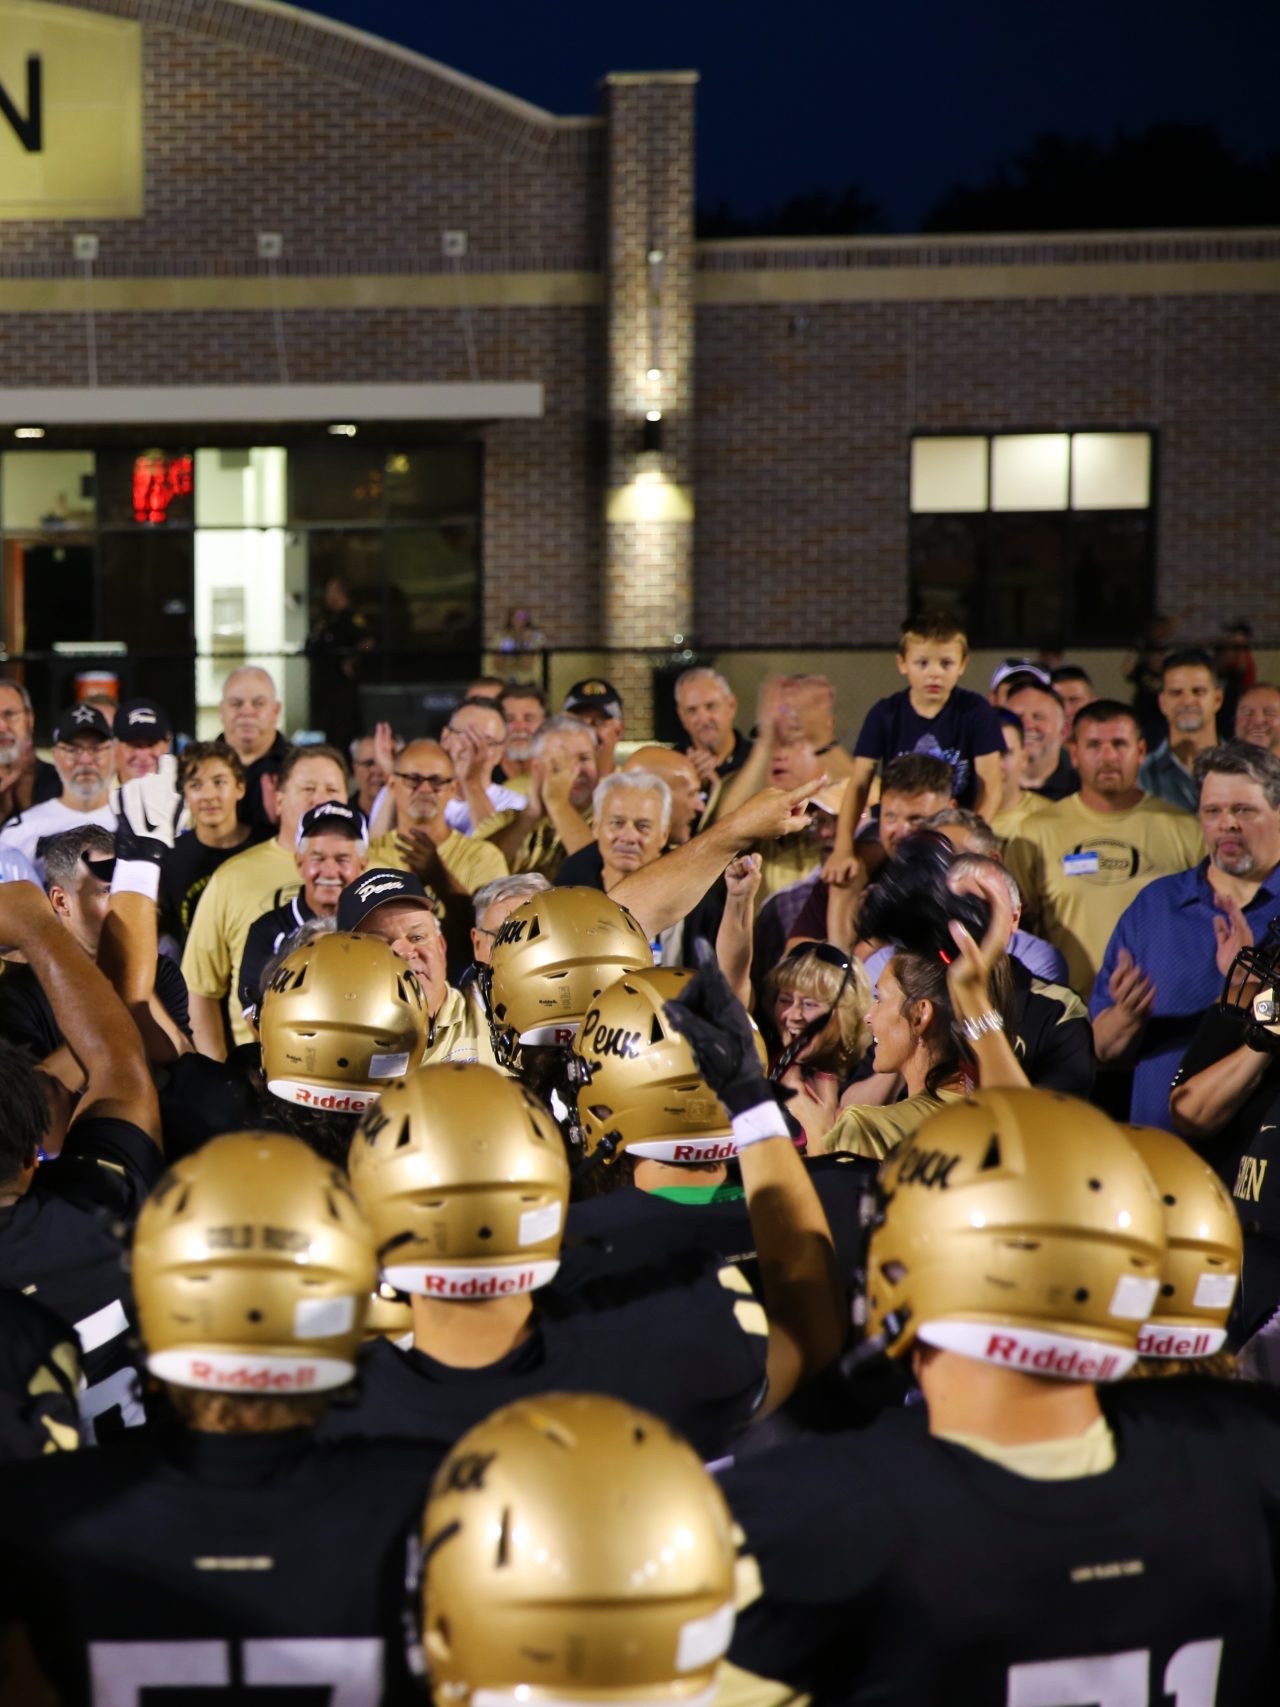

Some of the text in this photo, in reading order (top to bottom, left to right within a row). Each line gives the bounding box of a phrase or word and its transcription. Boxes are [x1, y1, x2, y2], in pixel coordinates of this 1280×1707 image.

[579, 1009, 642, 1060] Penn
[295, 1087, 376, 1112] Ridde
[425, 1271, 534, 1296] Riddell
[985, 1334, 1120, 1380] Riddell
[1136, 1334, 1210, 1355] ddell
[191, 1360, 317, 1391] Riddell
